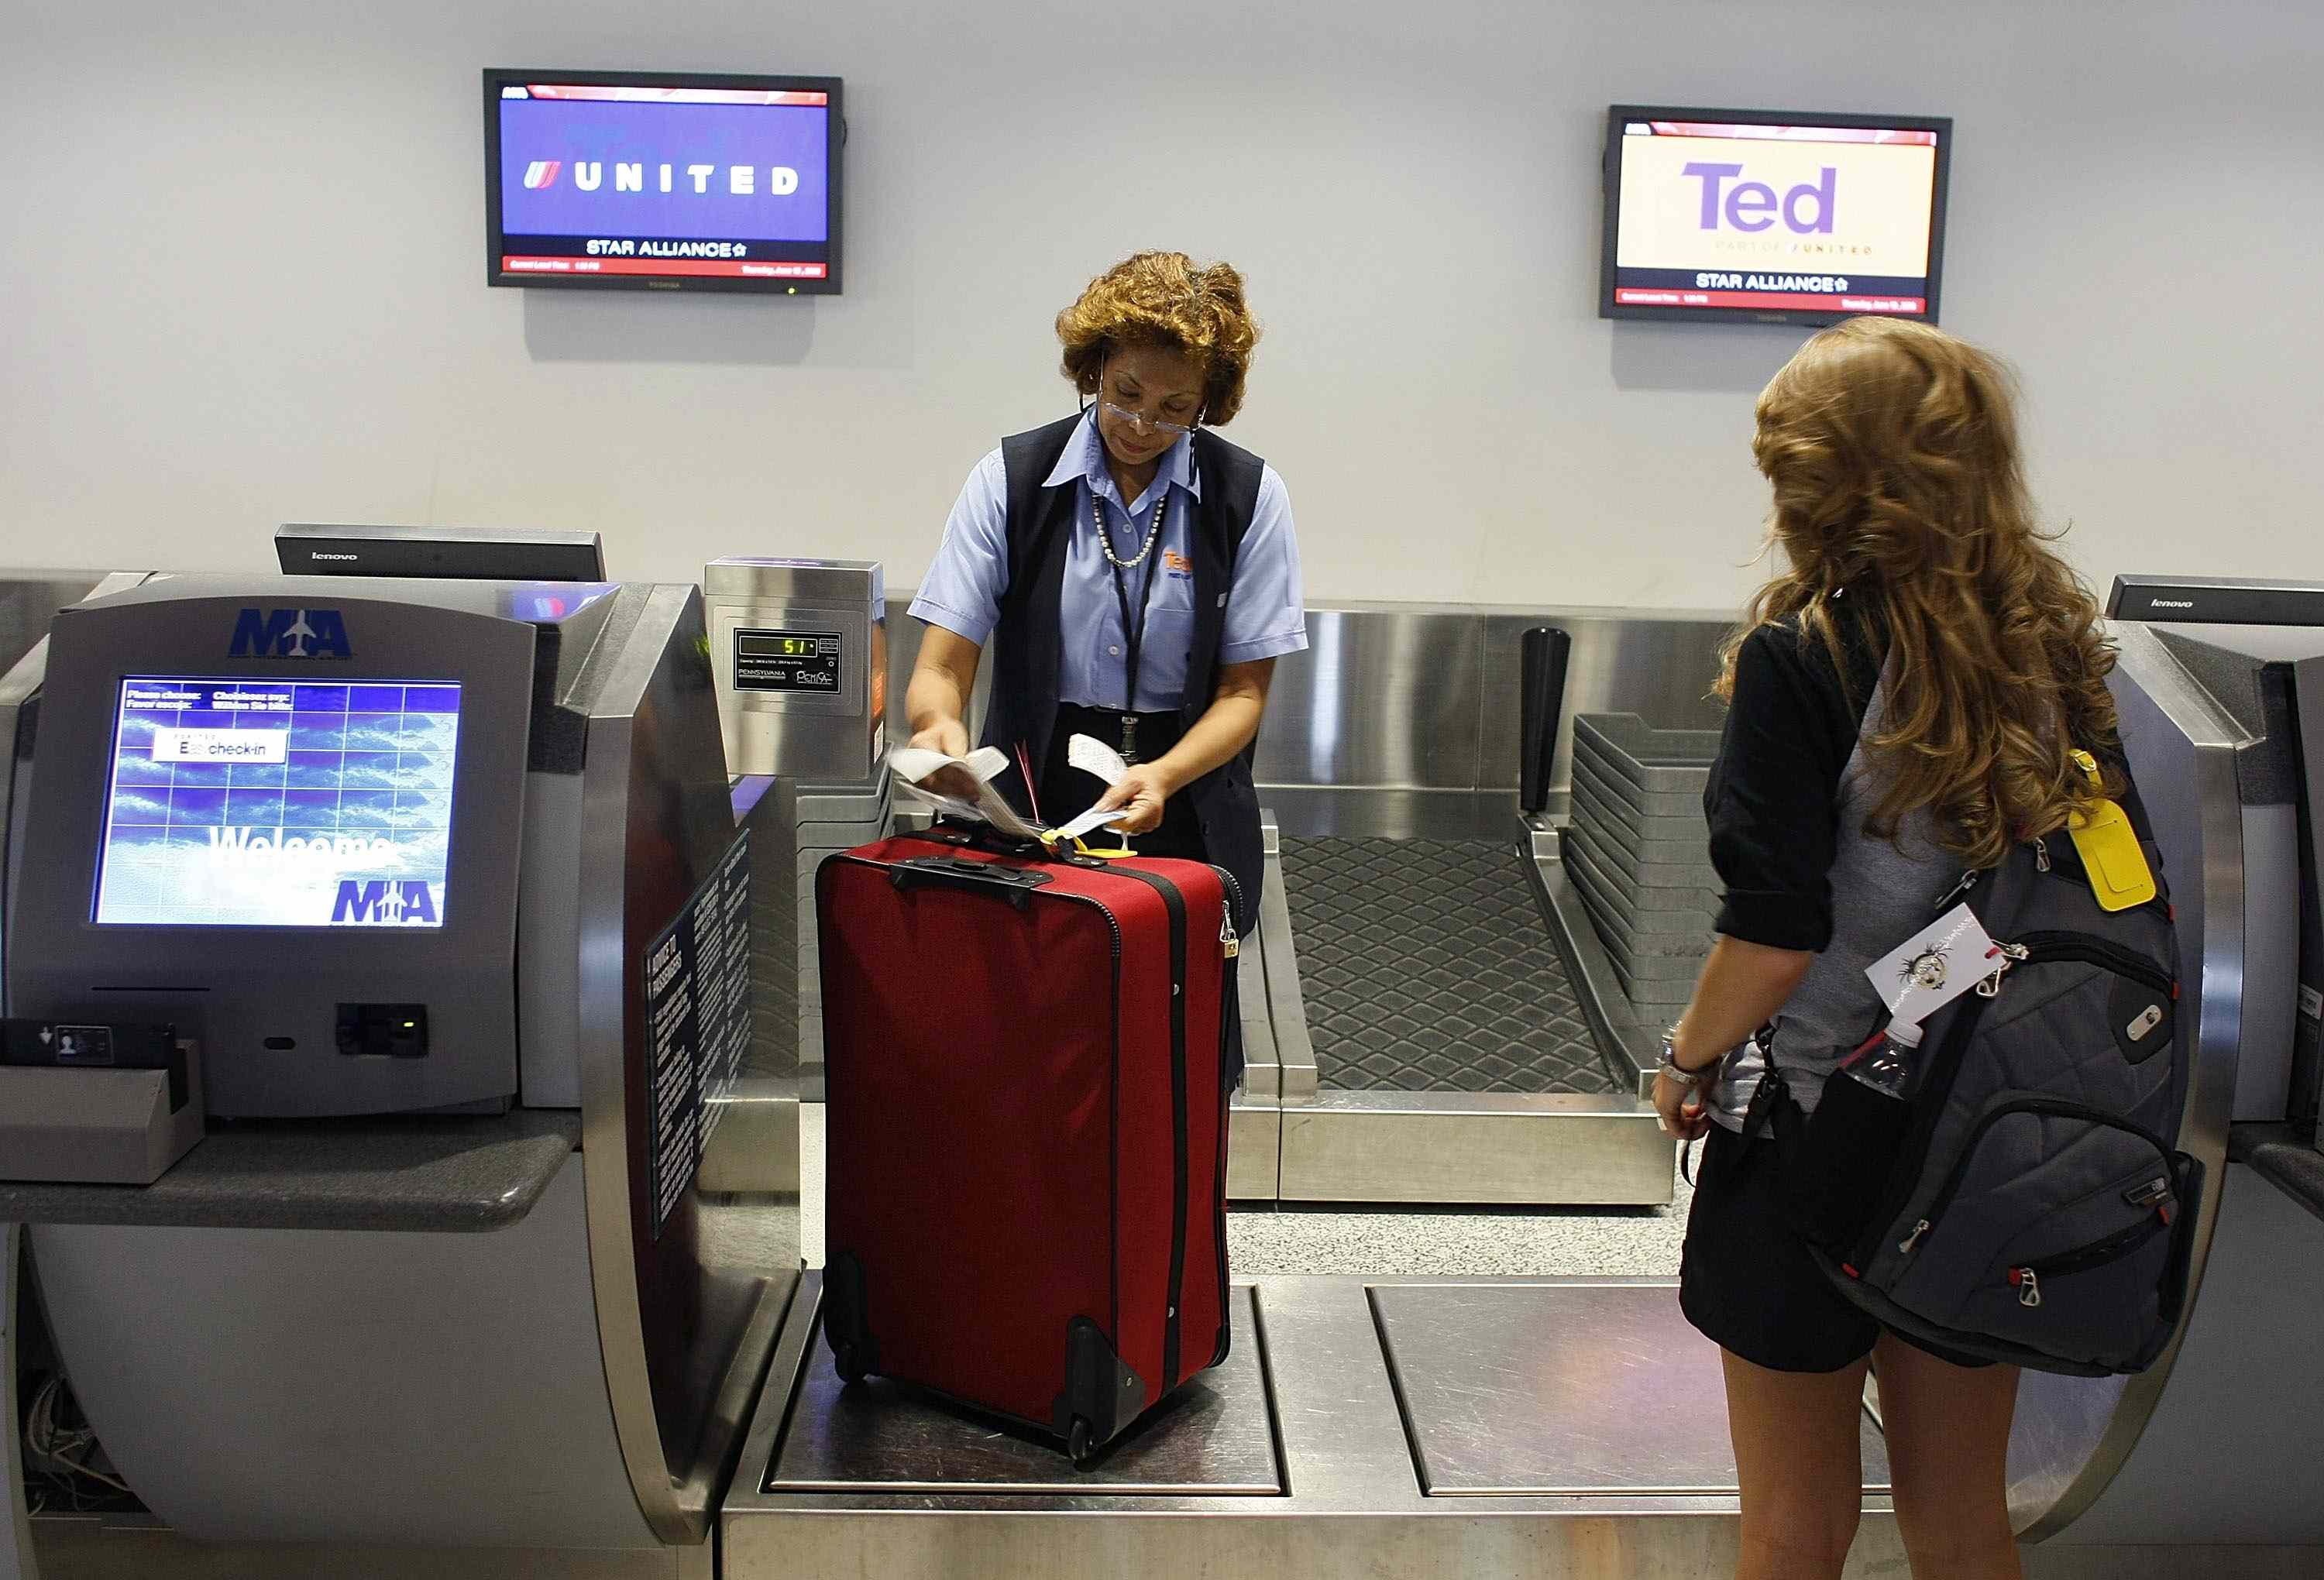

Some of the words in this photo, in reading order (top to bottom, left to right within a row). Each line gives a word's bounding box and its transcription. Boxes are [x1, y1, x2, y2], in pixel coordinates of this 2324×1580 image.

[575, 162, 799, 195] UNITED
[1681, 162, 1837, 234] Ted
[586, 239, 634, 256] STAR
[638, 241, 732, 258] ALLIANCE
[1696, 273, 1742, 290] STAR
[1745, 274, 1834, 293] ALLIANCE
[311, 551, 358, 561] lenovo
[2150, 598, 2193, 608] lenovo
[229, 608, 352, 657] MIA
[784, 640, 804, 654] 51
[208, 742, 266, 756] check-in
[210, 826, 398, 867] Welcome
[331, 881, 438, 922] MIA
